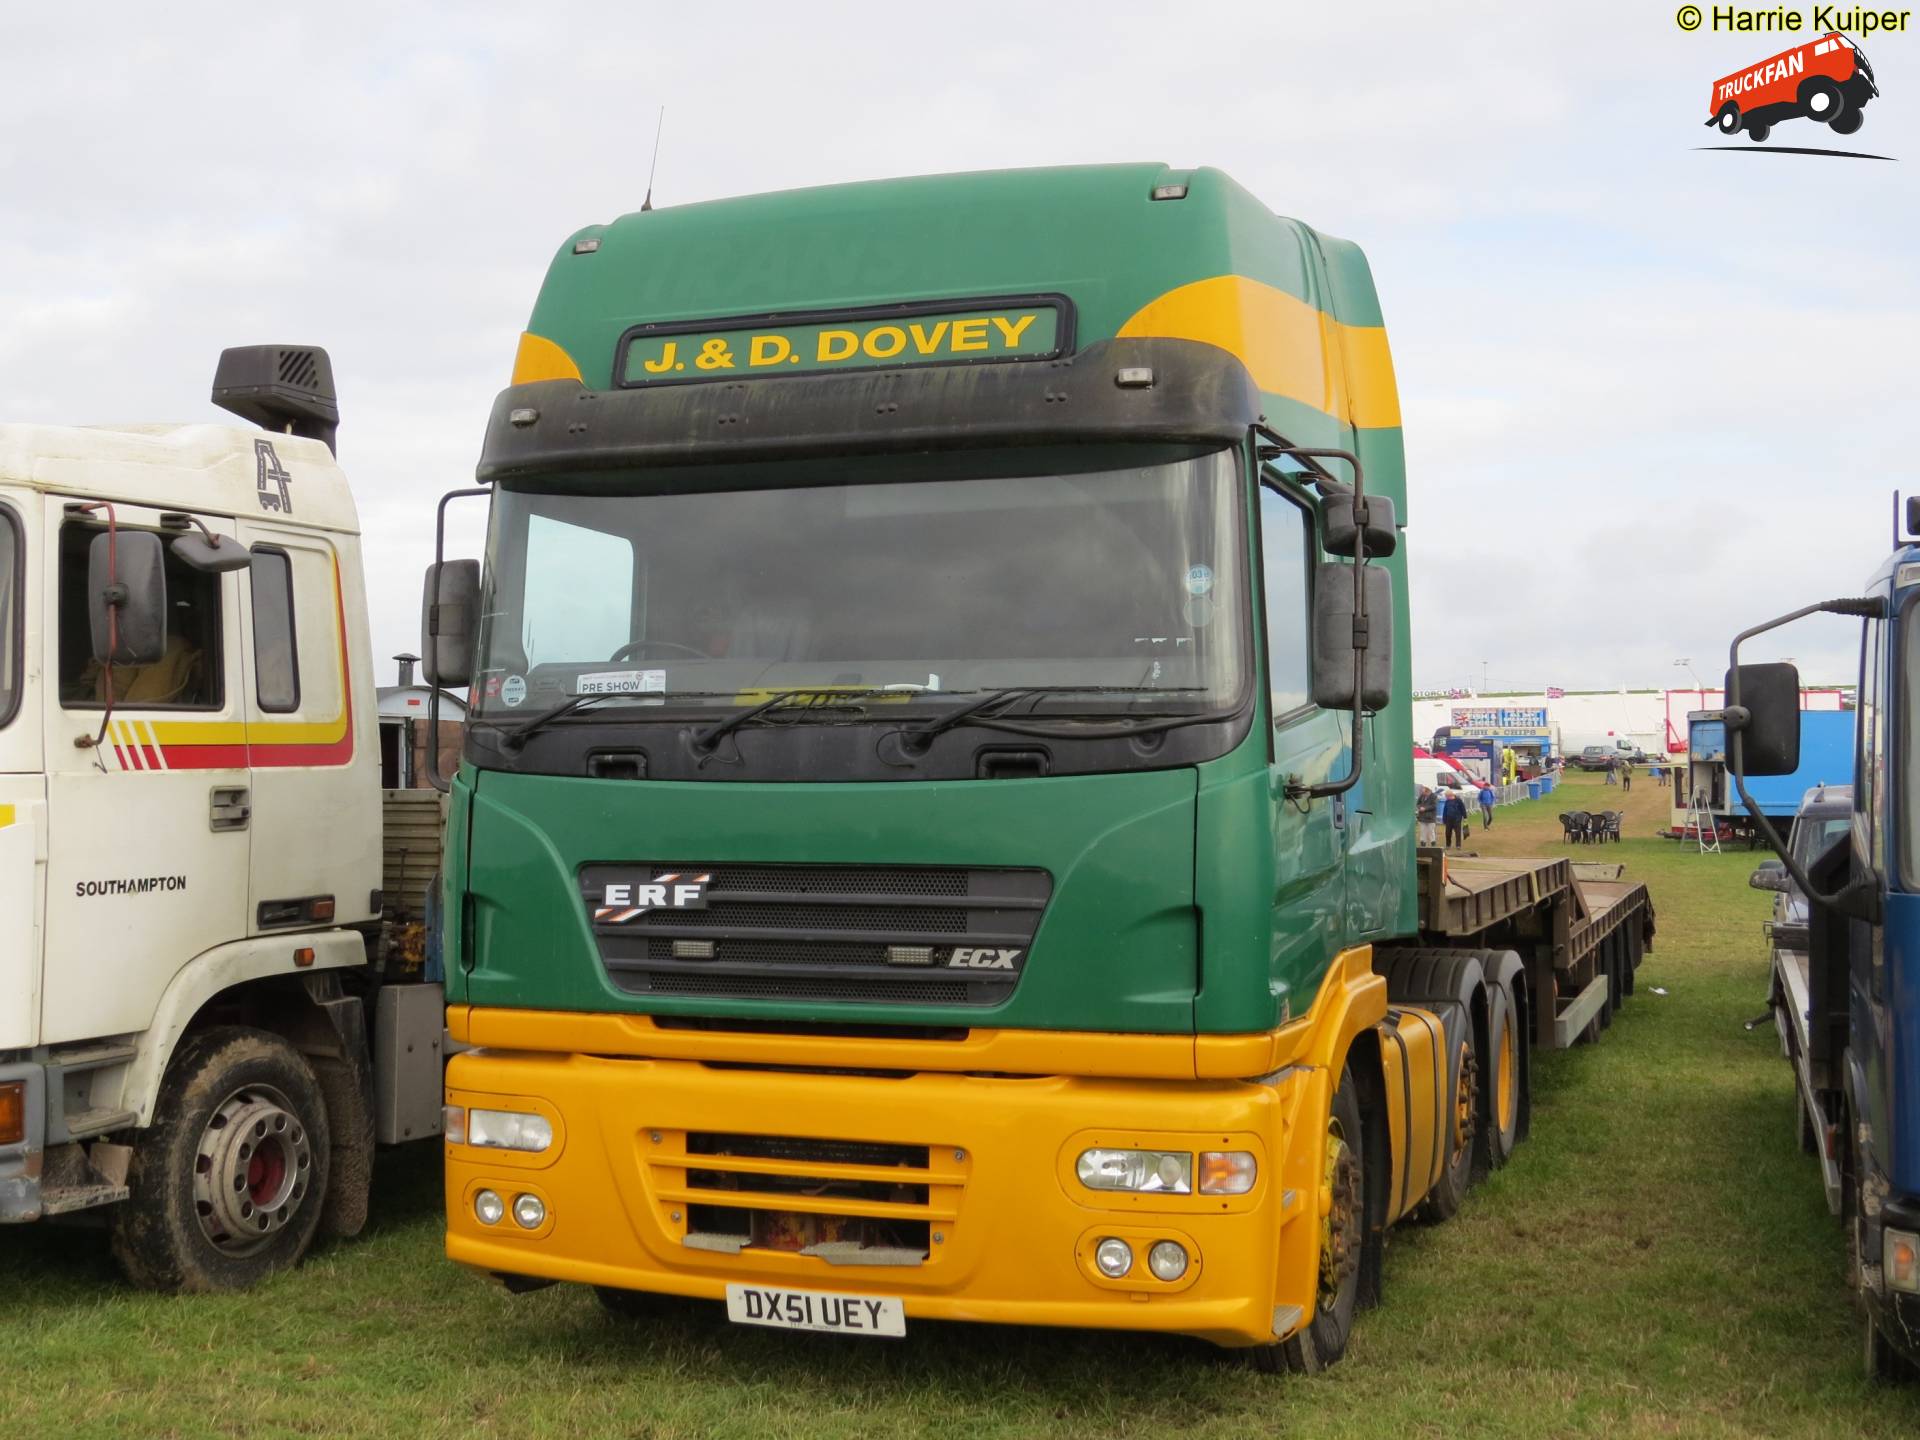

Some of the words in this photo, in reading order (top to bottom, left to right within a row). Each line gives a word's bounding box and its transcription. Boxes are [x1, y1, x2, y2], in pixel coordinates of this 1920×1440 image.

[644, 342, 684, 373] J.
[695, 338, 736, 370] &
[749, 334, 800, 366] D.
[816, 315, 1037, 362] DOVEY
[582, 682, 603, 693] PRE
[607, 681, 640, 692] SHOW
[76, 876, 187, 897] SOUTHAMPTON
[605, 884, 702, 907] ERF
[947, 948, 1023, 970] ECX
[744, 1290, 813, 1324] DX51
[821, 1297, 883, 1329] UEY
